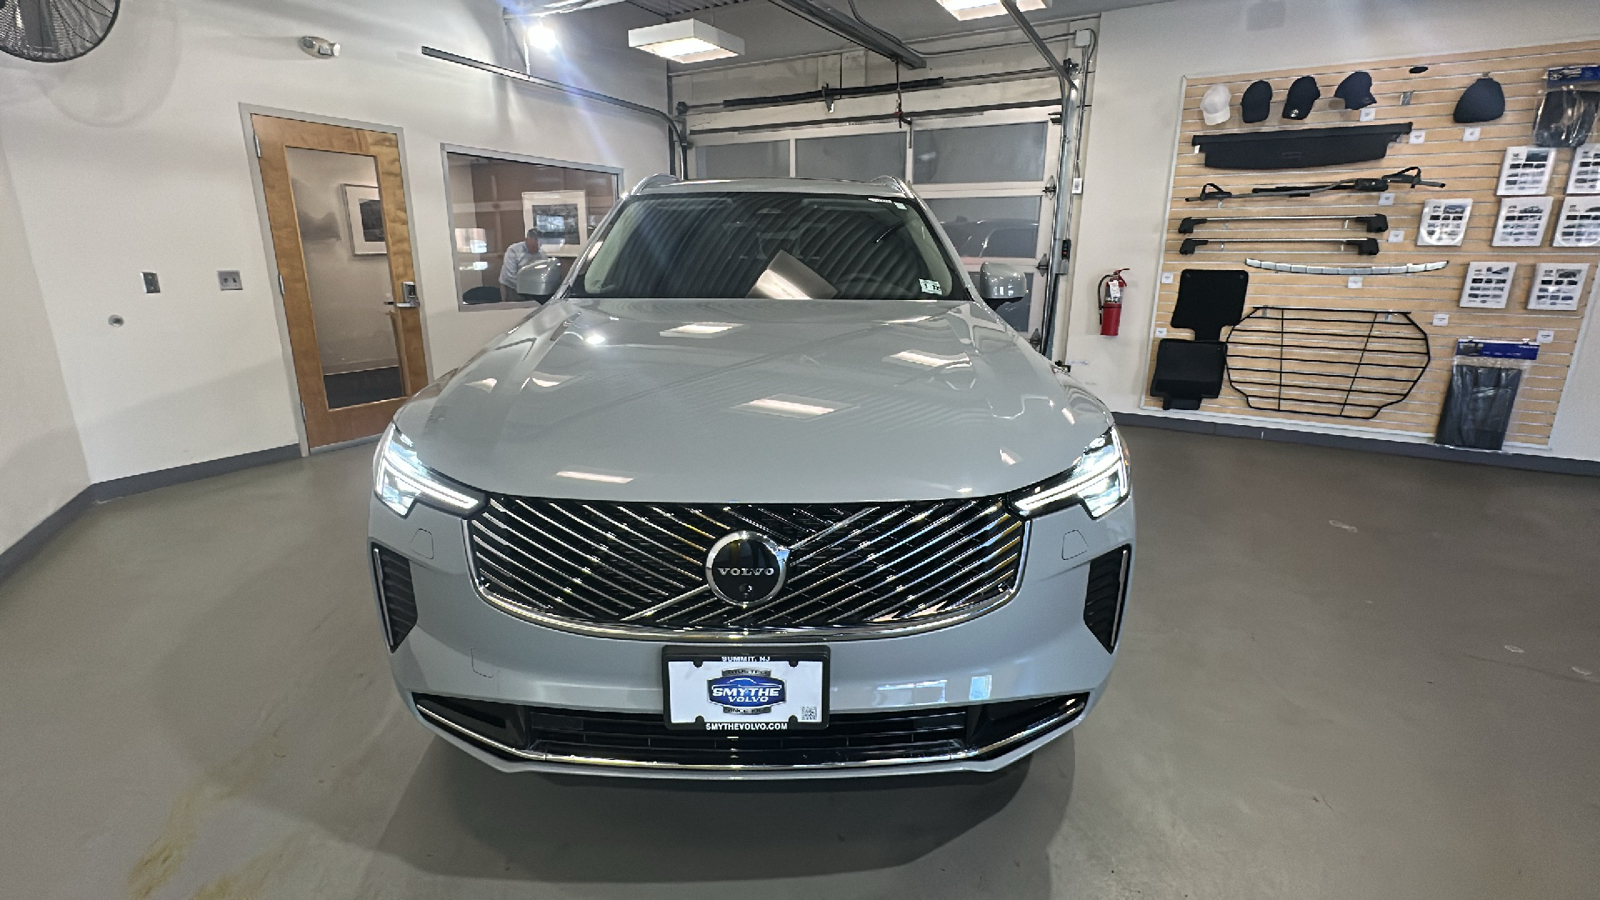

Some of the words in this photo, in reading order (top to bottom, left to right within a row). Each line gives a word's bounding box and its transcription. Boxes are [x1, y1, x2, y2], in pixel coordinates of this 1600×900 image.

[717, 567, 775, 576] VOLVO
[712, 688, 781, 697] SMYTHE
[706, 723, 788, 731] SMYTHEVOLVO.COM
